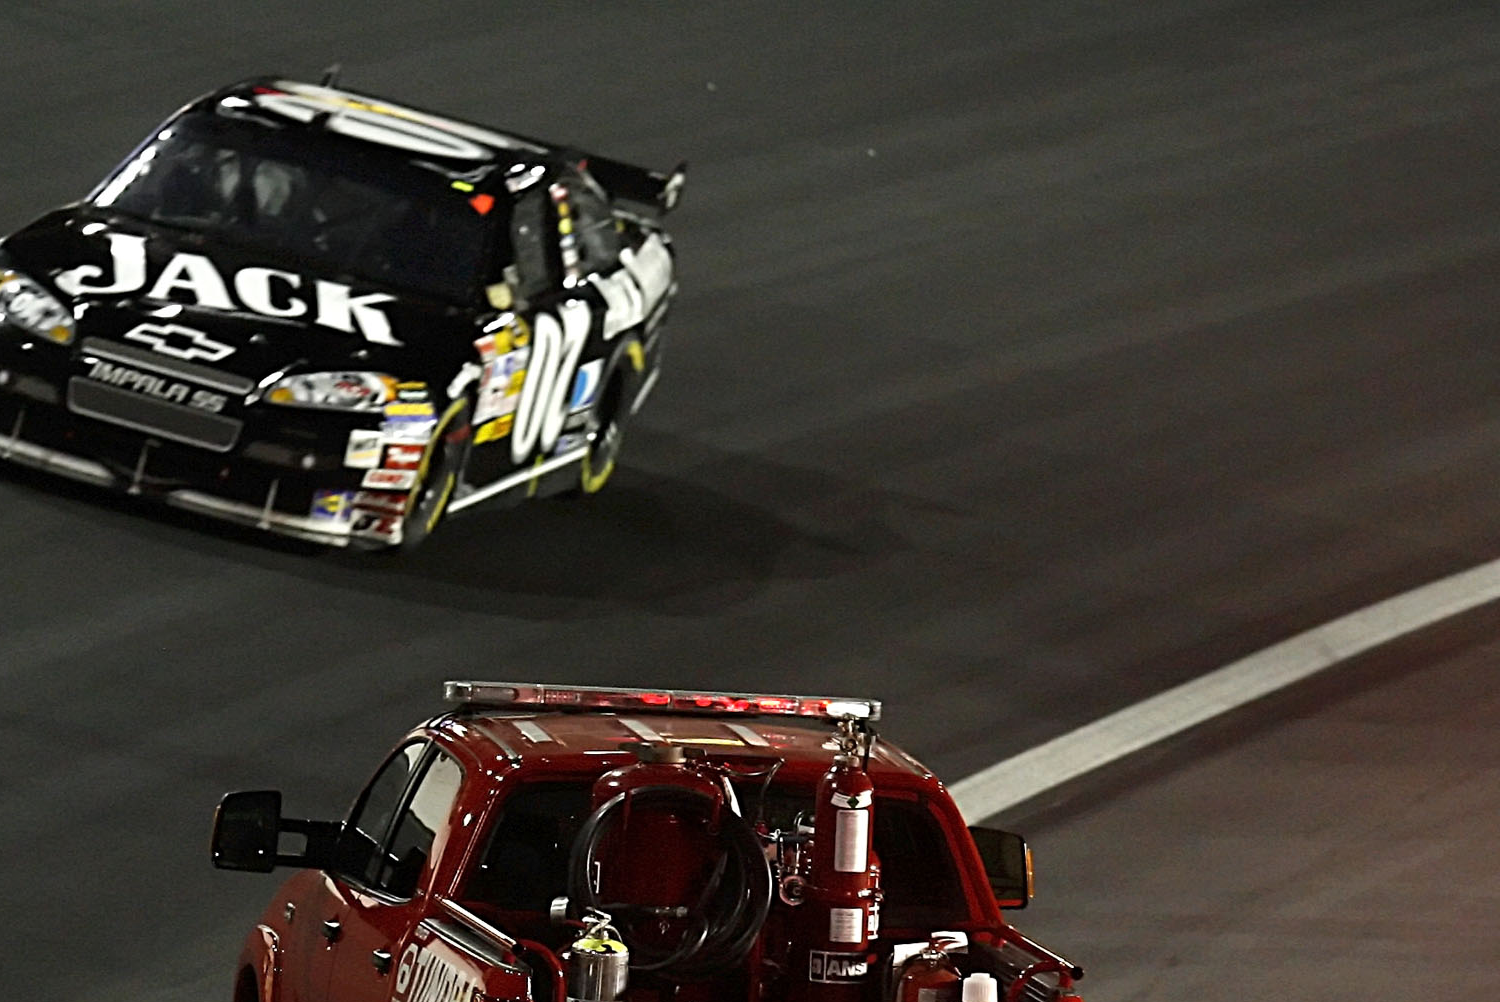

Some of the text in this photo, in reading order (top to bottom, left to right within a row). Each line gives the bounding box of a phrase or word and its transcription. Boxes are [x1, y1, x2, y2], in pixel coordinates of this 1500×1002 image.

[55, 232, 405, 347] JACK
[88, 361, 229, 414] IMPALA SS
